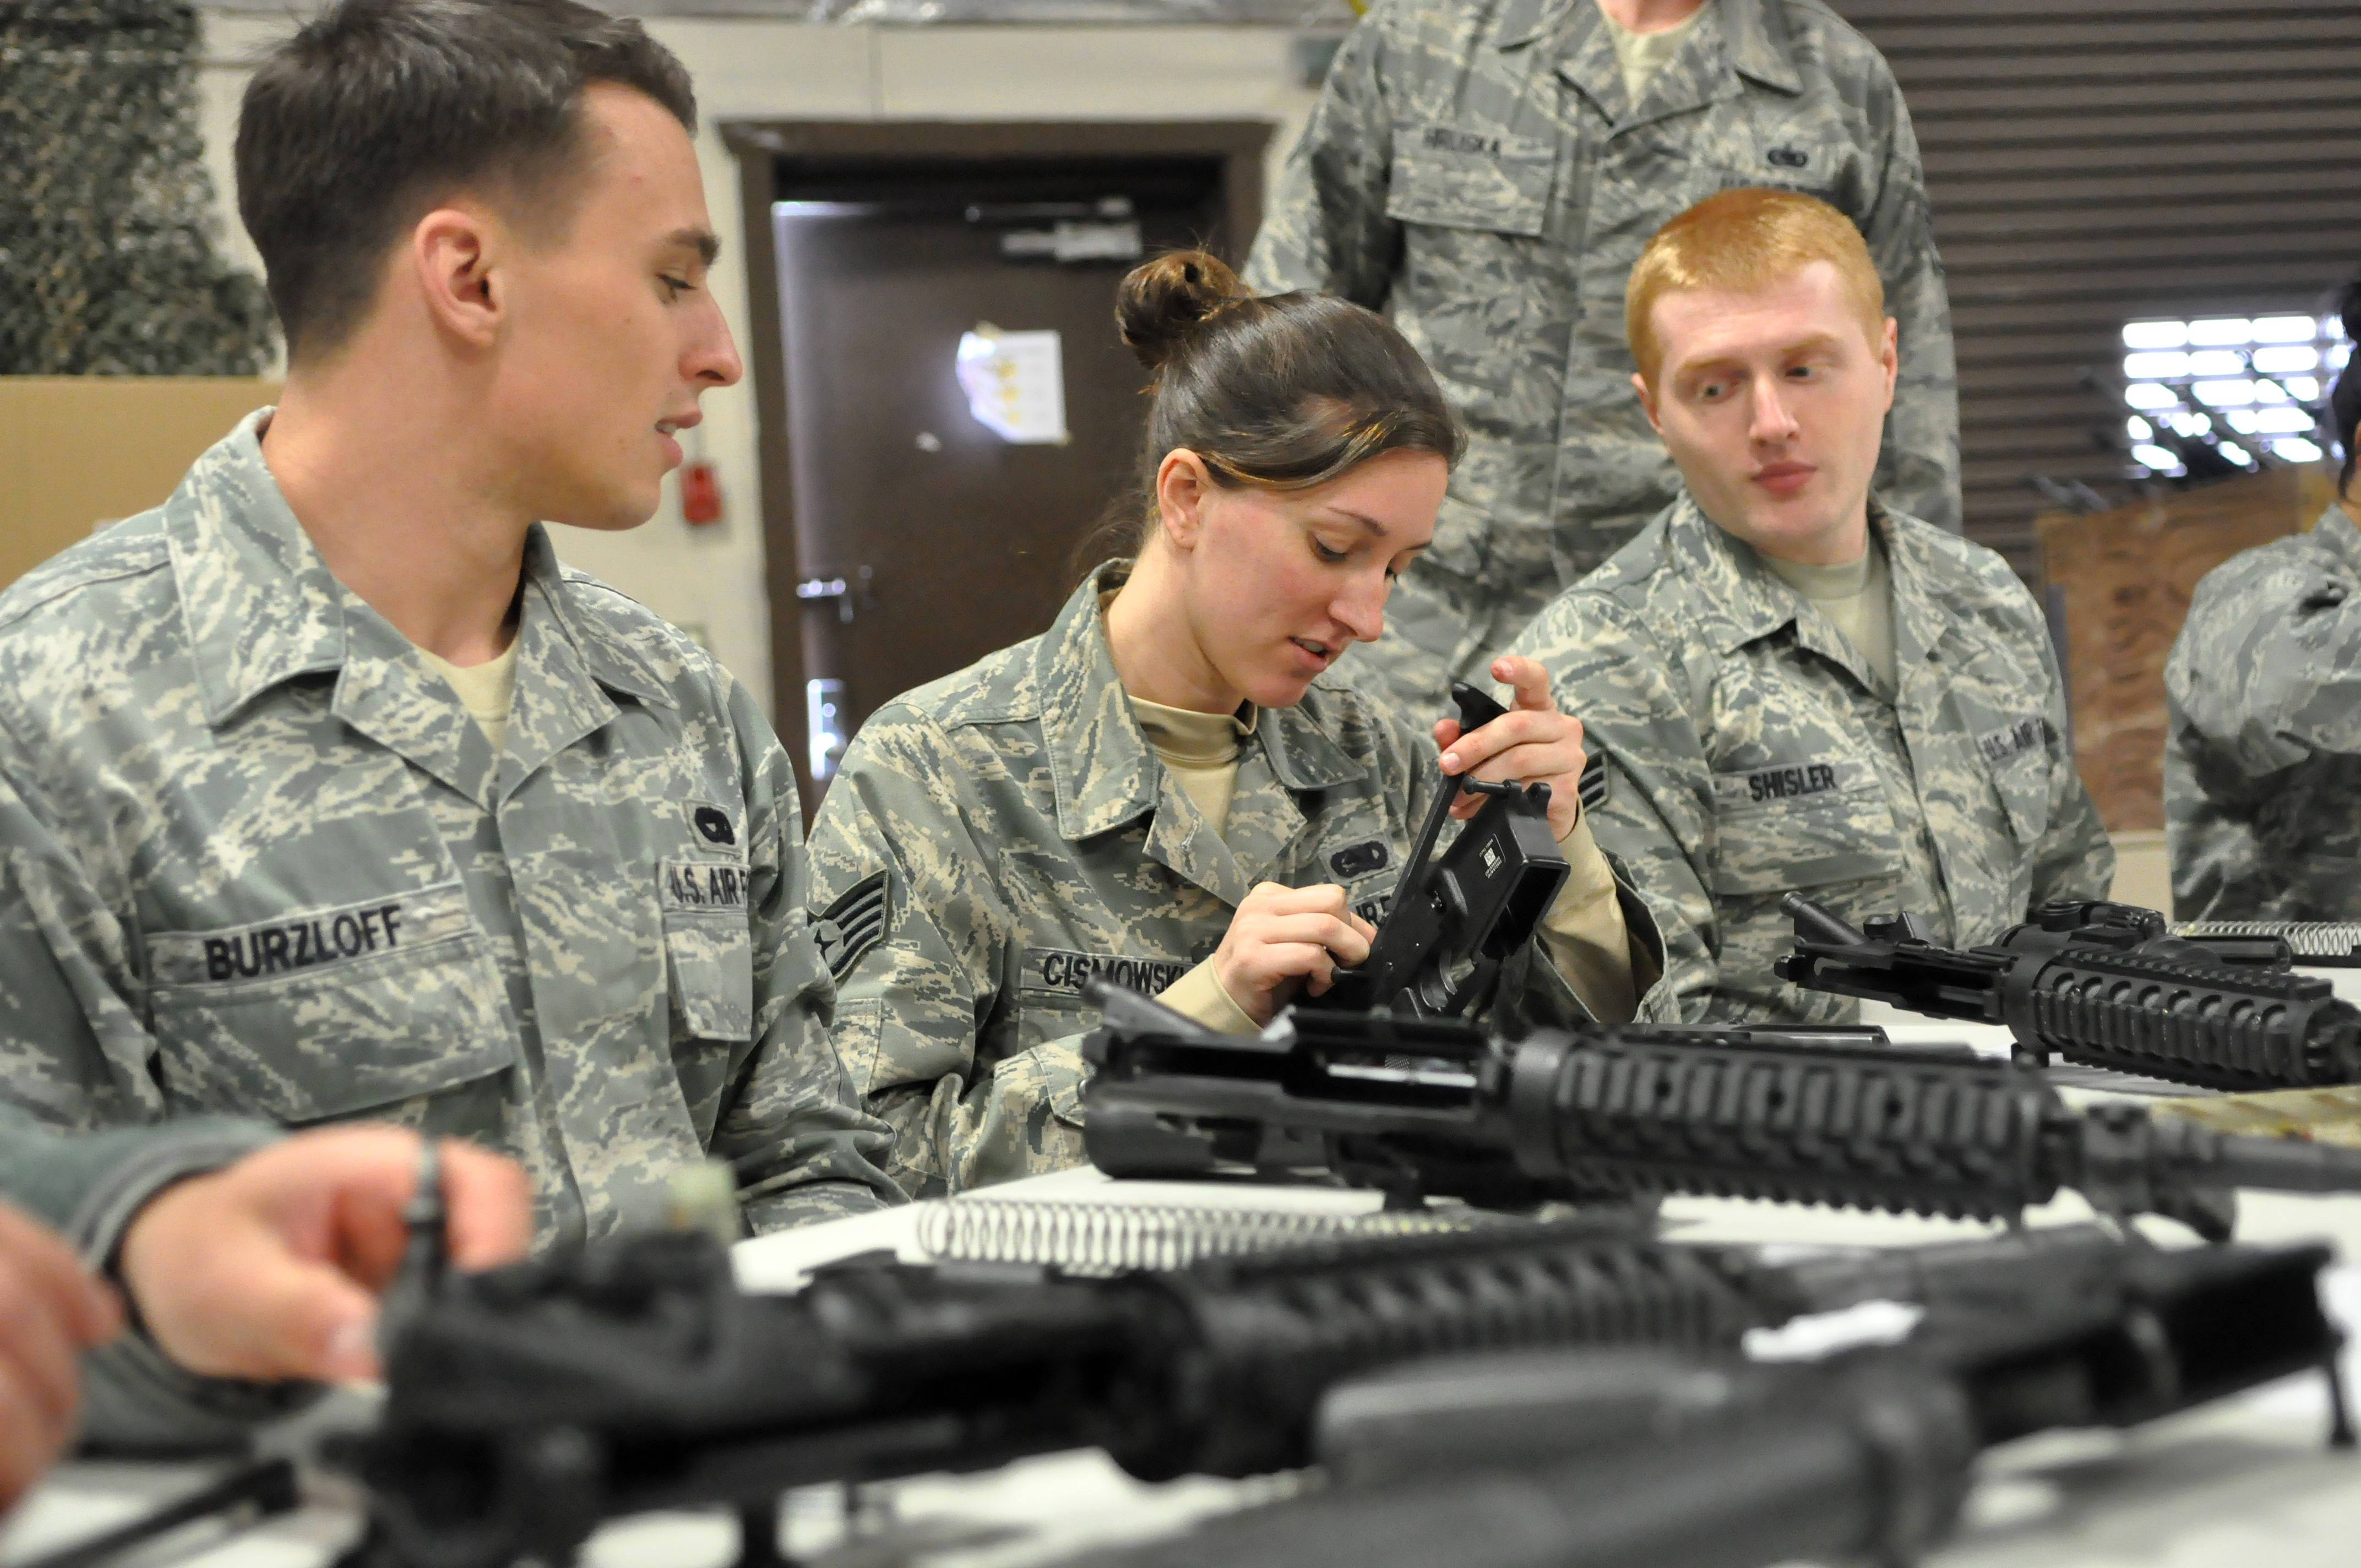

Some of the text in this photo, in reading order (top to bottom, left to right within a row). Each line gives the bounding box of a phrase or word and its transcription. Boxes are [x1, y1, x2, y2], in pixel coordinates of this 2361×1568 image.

[1749, 764, 1837, 802] SHISLER
[670, 867, 705, 904] U.S.
[710, 867, 739, 905] AIR
[204, 905, 401, 981] BURZLOFF
